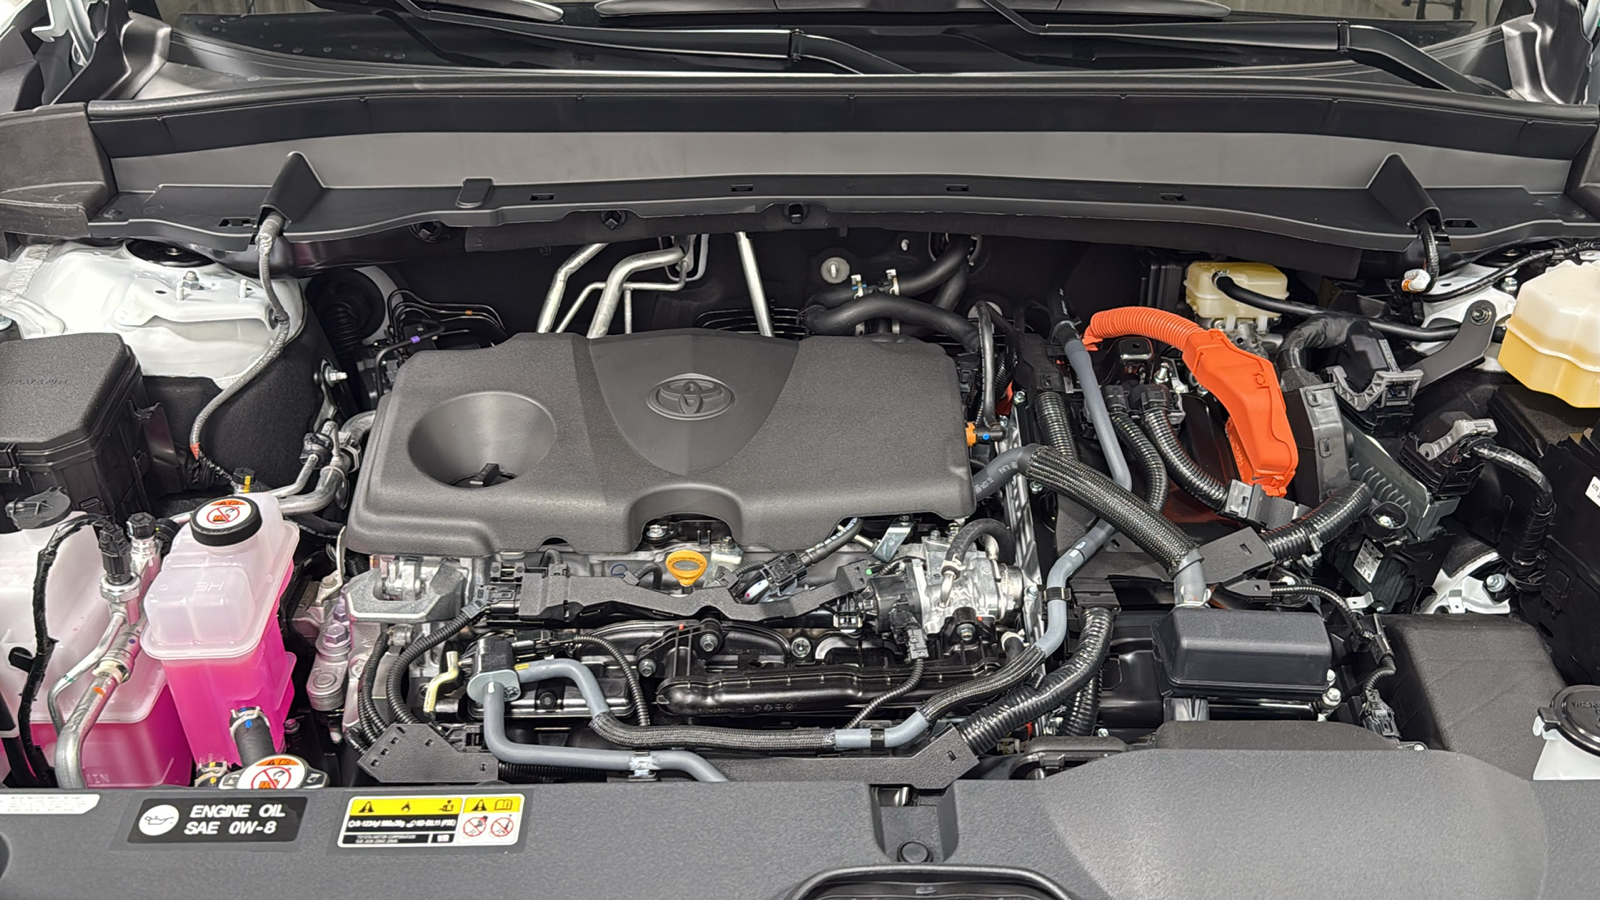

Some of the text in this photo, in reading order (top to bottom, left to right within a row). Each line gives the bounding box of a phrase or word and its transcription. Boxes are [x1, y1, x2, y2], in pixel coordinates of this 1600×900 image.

[189, 803, 286, 818] ENGINE OIL
[183, 820, 277, 835] SAE 0W-8
